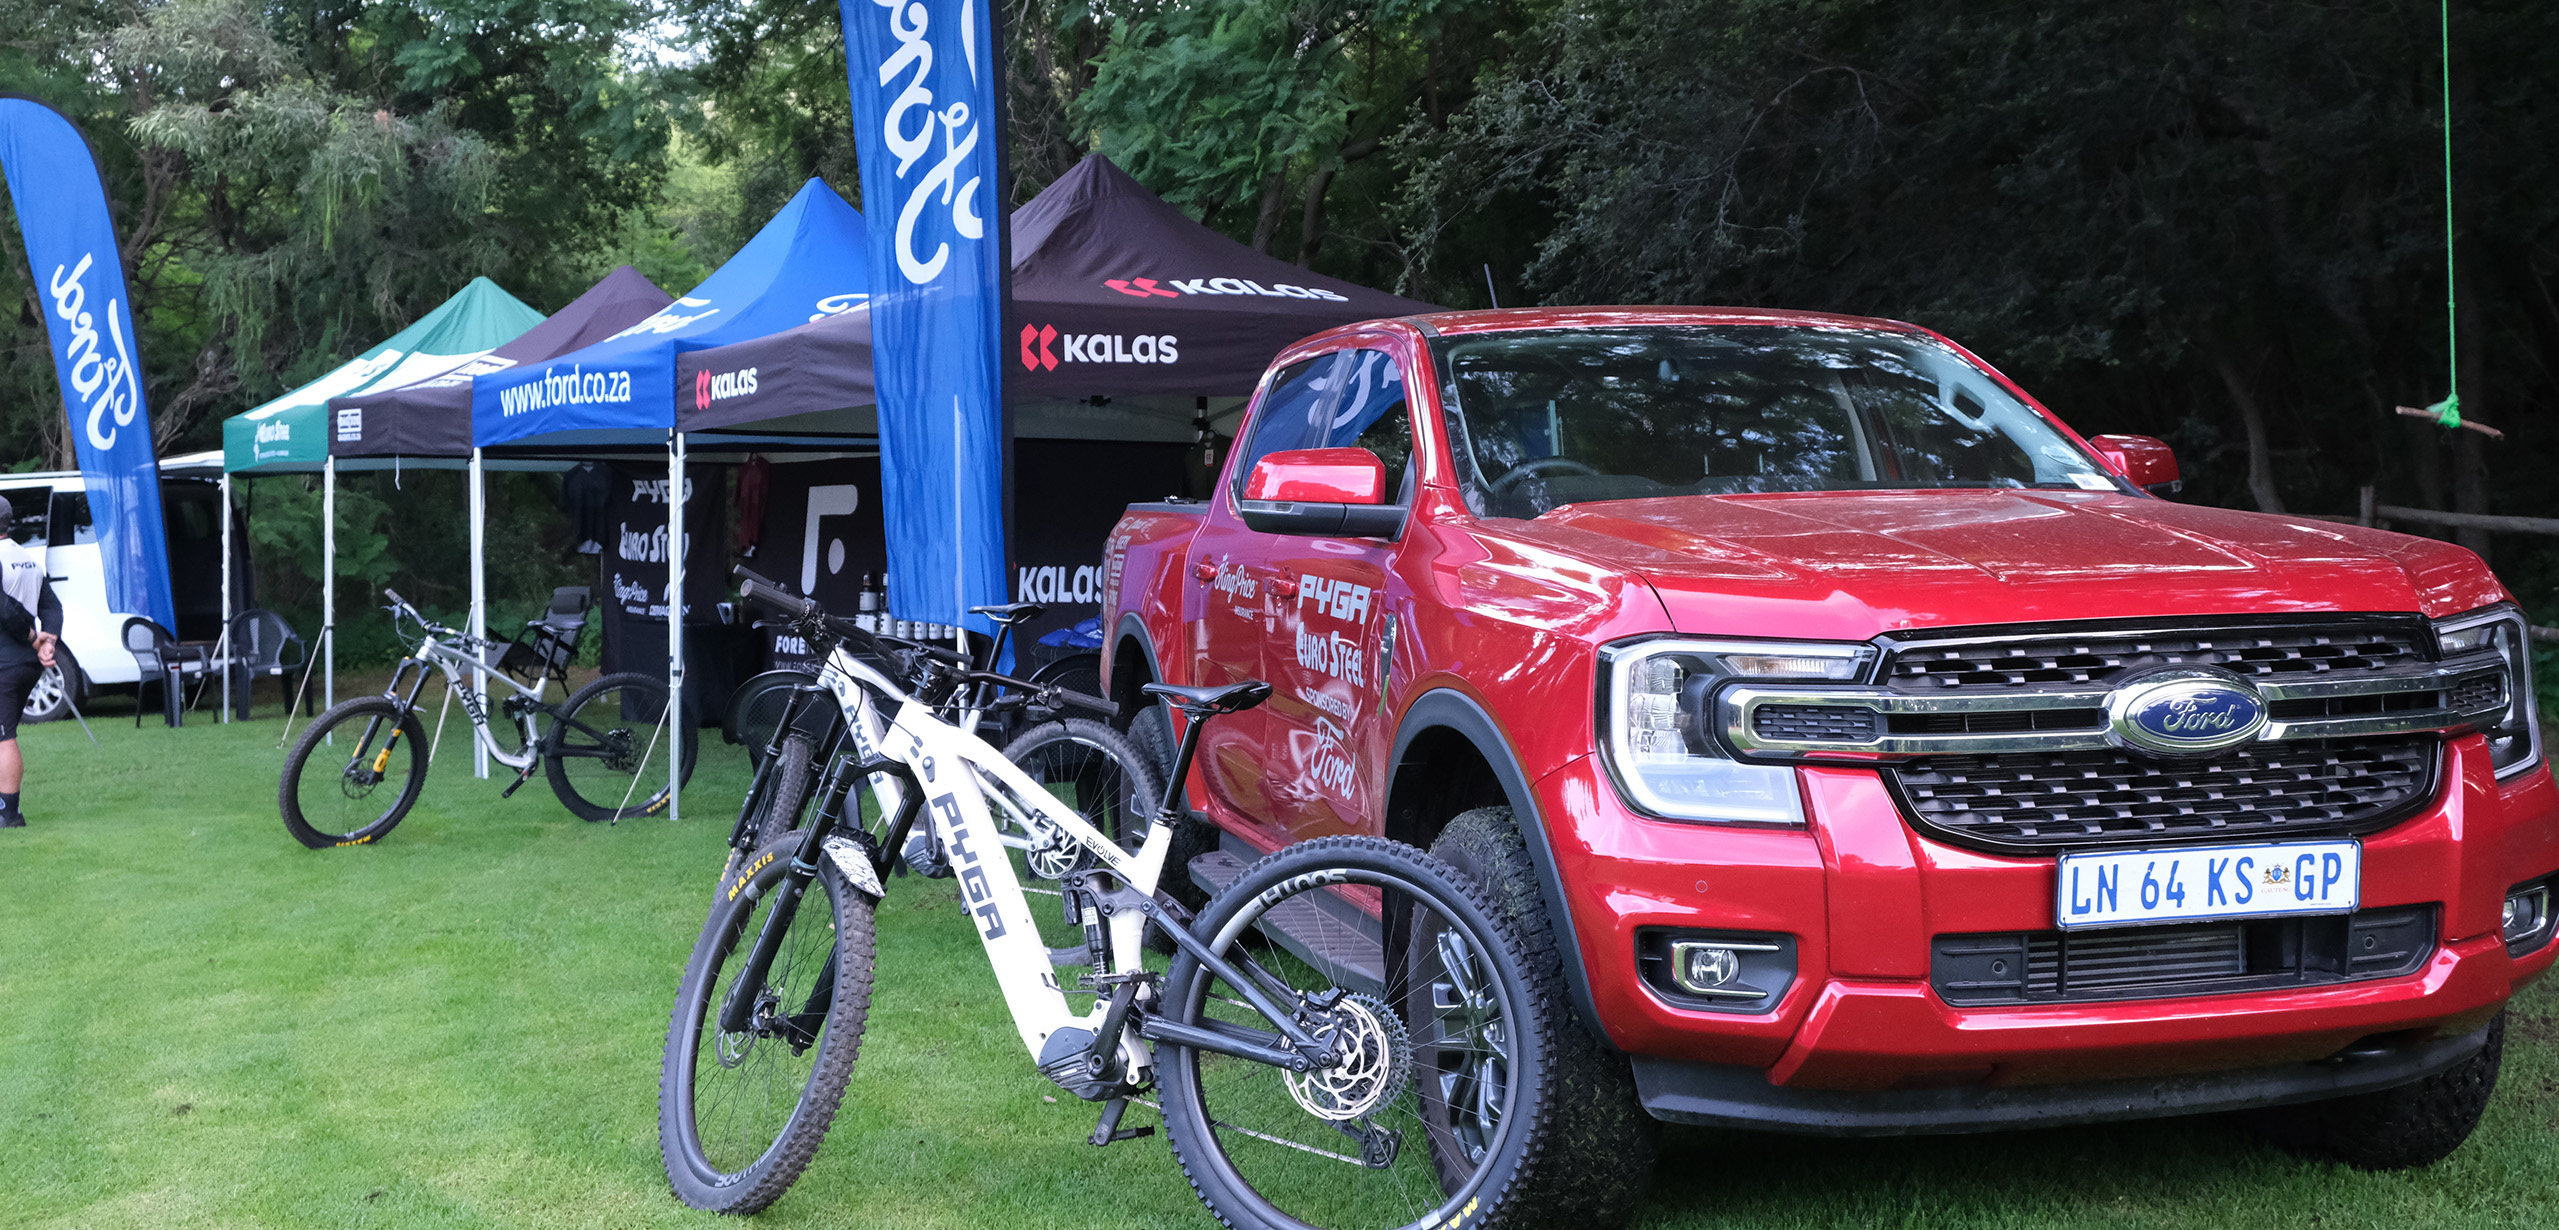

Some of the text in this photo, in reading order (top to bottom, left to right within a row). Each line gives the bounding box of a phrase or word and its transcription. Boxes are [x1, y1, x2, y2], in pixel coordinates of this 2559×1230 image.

[500, 364, 632, 417] www.ford.co.za
[1297, 574, 1371, 625] PYGA
[454, 680, 484, 726] PYGA
[1305, 687, 1351, 722] SPONSORED BY
[2164, 697, 2235, 732] Ford
[1311, 716, 1356, 800] Ford
[728, 852, 774, 901] MAXXIS
[931, 791, 1006, 940] PYGA
[2072, 852, 2342, 915] LN 64 KS GP
